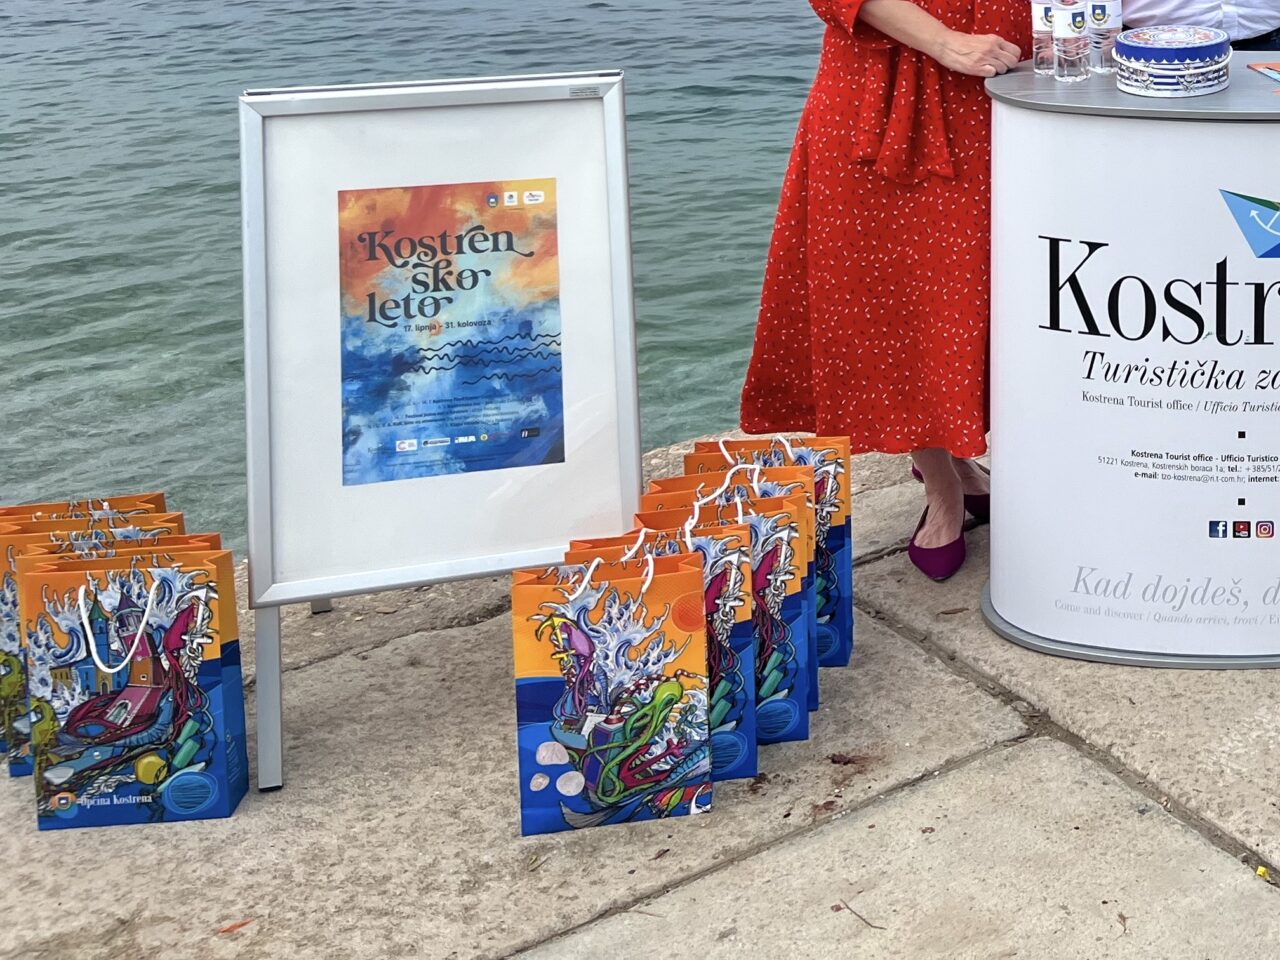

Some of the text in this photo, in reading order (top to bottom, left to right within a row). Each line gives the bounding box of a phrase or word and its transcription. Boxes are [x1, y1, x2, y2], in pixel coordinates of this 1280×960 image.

[366, 292, 453, 328] leto
[415, 323, 437, 333] lipnja
[445, 321, 456, 329] 31.
[457, 319, 492, 328] kolovoza
[1082, 350, 1246, 390] Turistička
[1082, 391, 1124, 406] Kostrena
[1127, 395, 1163, 409] Tourist
[1166, 399, 1193, 411] office
[1203, 400, 1239, 414] Ufficio
[1097, 456, 1118, 465] 51221
[1120, 459, 1149, 469] Kostrena,
[1152, 462, 1188, 471] Kostrenskih
[1190, 464, 1213, 472] boraca
[1131, 449, 1163, 460] Kostrena
[1165, 452, 1190, 461] Tourist
[1192, 453, 1213, 462] office
[1220, 454, 1245, 462] Ufficio
[1247, 454, 1279, 463] Turistico
[1134, 471, 1159, 480] e-mail:
[1248, 474, 1280, 482] internet:
[1070, 565, 1133, 600] Kad
[1141, 574, 1249, 613] dojdeš,
[1054, 599, 1080, 613] Come
[1083, 605, 1101, 616] and
[1104, 606, 1144, 621] discover
[1153, 611, 1193, 624] Quando
[113, 793, 153, 805] Kostrena
